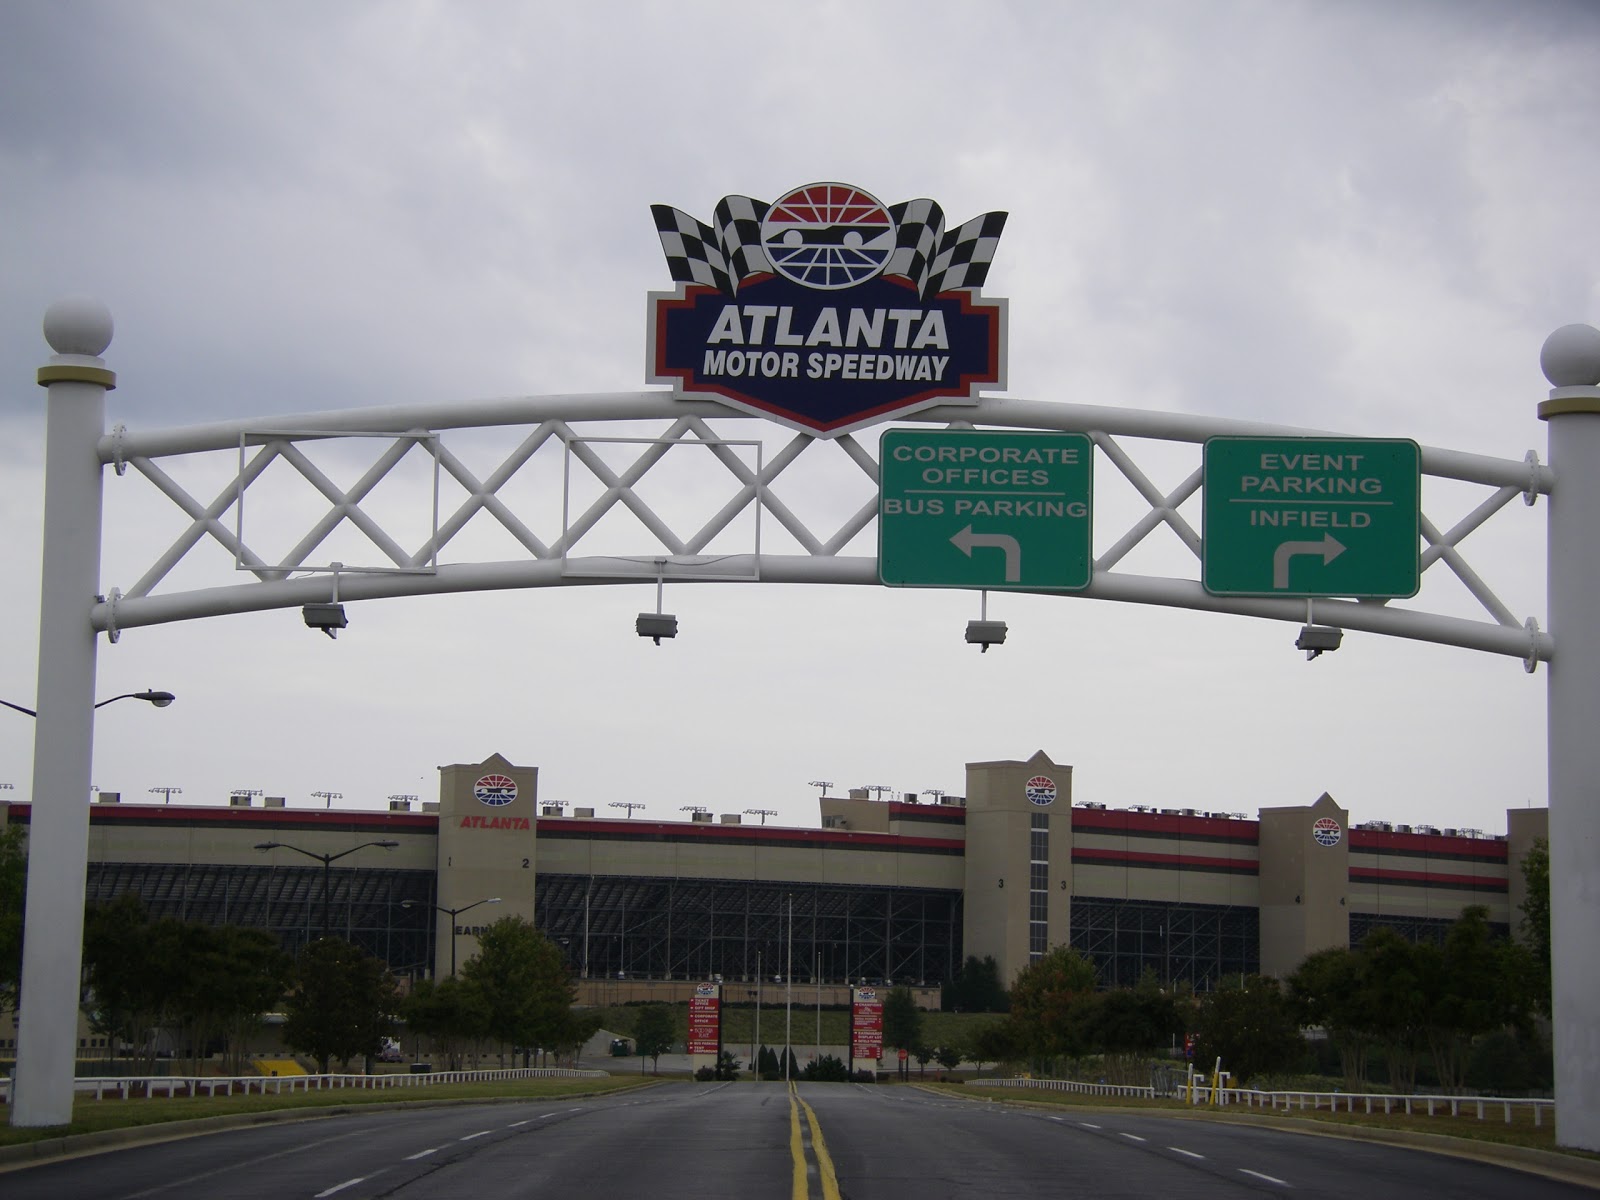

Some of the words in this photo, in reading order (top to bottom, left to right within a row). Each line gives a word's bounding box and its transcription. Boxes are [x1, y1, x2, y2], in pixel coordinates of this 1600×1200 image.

[706, 304, 950, 350] ATLANTA
[703, 349, 800, 378] MOTOR
[806, 353, 950, 382] SPEEDWAY
[893, 445, 1079, 465] CORPORATE
[1260, 453, 1364, 471] EVENT
[922, 468, 1049, 486] OFFICES
[1241, 476, 1382, 495] PARKING
[883, 499, 944, 515] BUS
[954, 500, 1088, 518] PARKING
[1250, 510, 1371, 528] INFIELD
[460, 815, 530, 830] ATLANTA
[522, 858, 530, 869] 2
[998, 879, 1004, 889] 3
[1060, 881, 1067, 890] 3
[1295, 895, 1301, 904] 4
[455, 926, 489, 936] EARN
